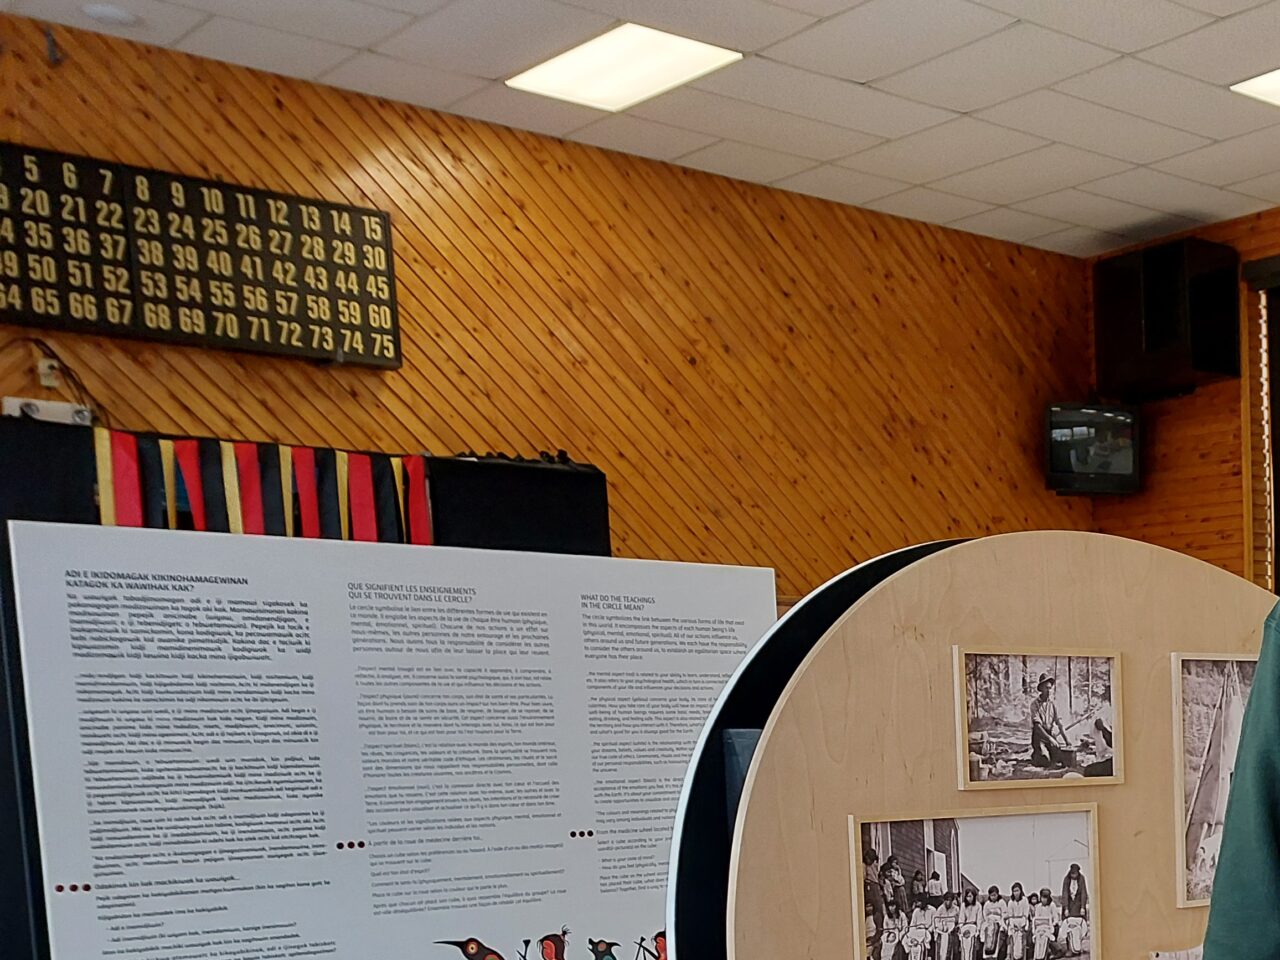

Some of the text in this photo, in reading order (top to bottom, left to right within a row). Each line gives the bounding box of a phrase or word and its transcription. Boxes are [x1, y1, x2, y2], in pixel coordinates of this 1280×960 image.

[20, 187, 50, 216] 20
[60, 194, 86, 222] 21
[95, 200, 124, 229] 22
[133, 207, 160, 234] 23
[167, 212, 195, 240] 24
[202, 217, 228, 245] 25
[235, 223, 262, 251] 26
[268, 229, 293, 256] 27
[300, 234, 326, 262] 28
[331, 239, 357, 267] 29
[362, 244, 387, 271] 30
[24, 155, 383, 242] 5 6 7 8 9 10 11 12 13 14 15
[24, 220, 53, 249] 35
[62, 227, 90, 255] 36
[99, 233, 126, 260] 37
[137, 238, 164, 266] 38
[172, 244, 199, 271] 39
[206, 250, 233, 277] 40
[240, 254, 264, 281] 41
[272, 259, 298, 287] 42
[304, 265, 329, 292] 43
[334, 269, 360, 296] 44
[365, 274, 390, 301] 45
[27, 254, 56, 283] 50
[67, 260, 92, 288] 51
[103, 265, 130, 294] 52
[140, 270, 168, 298] 53
[175, 275, 202, 303] 54
[209, 280, 236, 308] 55
[242, 284, 269, 312] 56
[275, 289, 299, 316] 57
[306, 294, 331, 322] 58
[337, 298, 362, 326] 59
[368, 303, 392, 330] 60
[31, 287, 60, 315] 65
[69, 292, 97, 320] 66
[106, 297, 132, 324] 67
[144, 302, 171, 330] 68
[178, 307, 206, 334] 69
[212, 311, 239, 339] 70
[246, 315, 270, 342] 71
[276, 320, 303, 347] 72
[308, 324, 334, 351] 73
[340, 328, 364, 355] 74
[370, 332, 395, 359] 75
[348, 582, 477, 595] QUE SIGNIFIENT LES ENSEIGNEMENTS
[348, 591, 362, 599] QUI
[364, 591, 372, 600] SE
[374, 592, 412, 601] TROUVENT
[413, 594, 433, 602] DANS
[443, 595, 473, 604] CERCLE?
[623, 596, 656, 604] TEACHINGS
[624, 603, 645, 611] MEAN?
